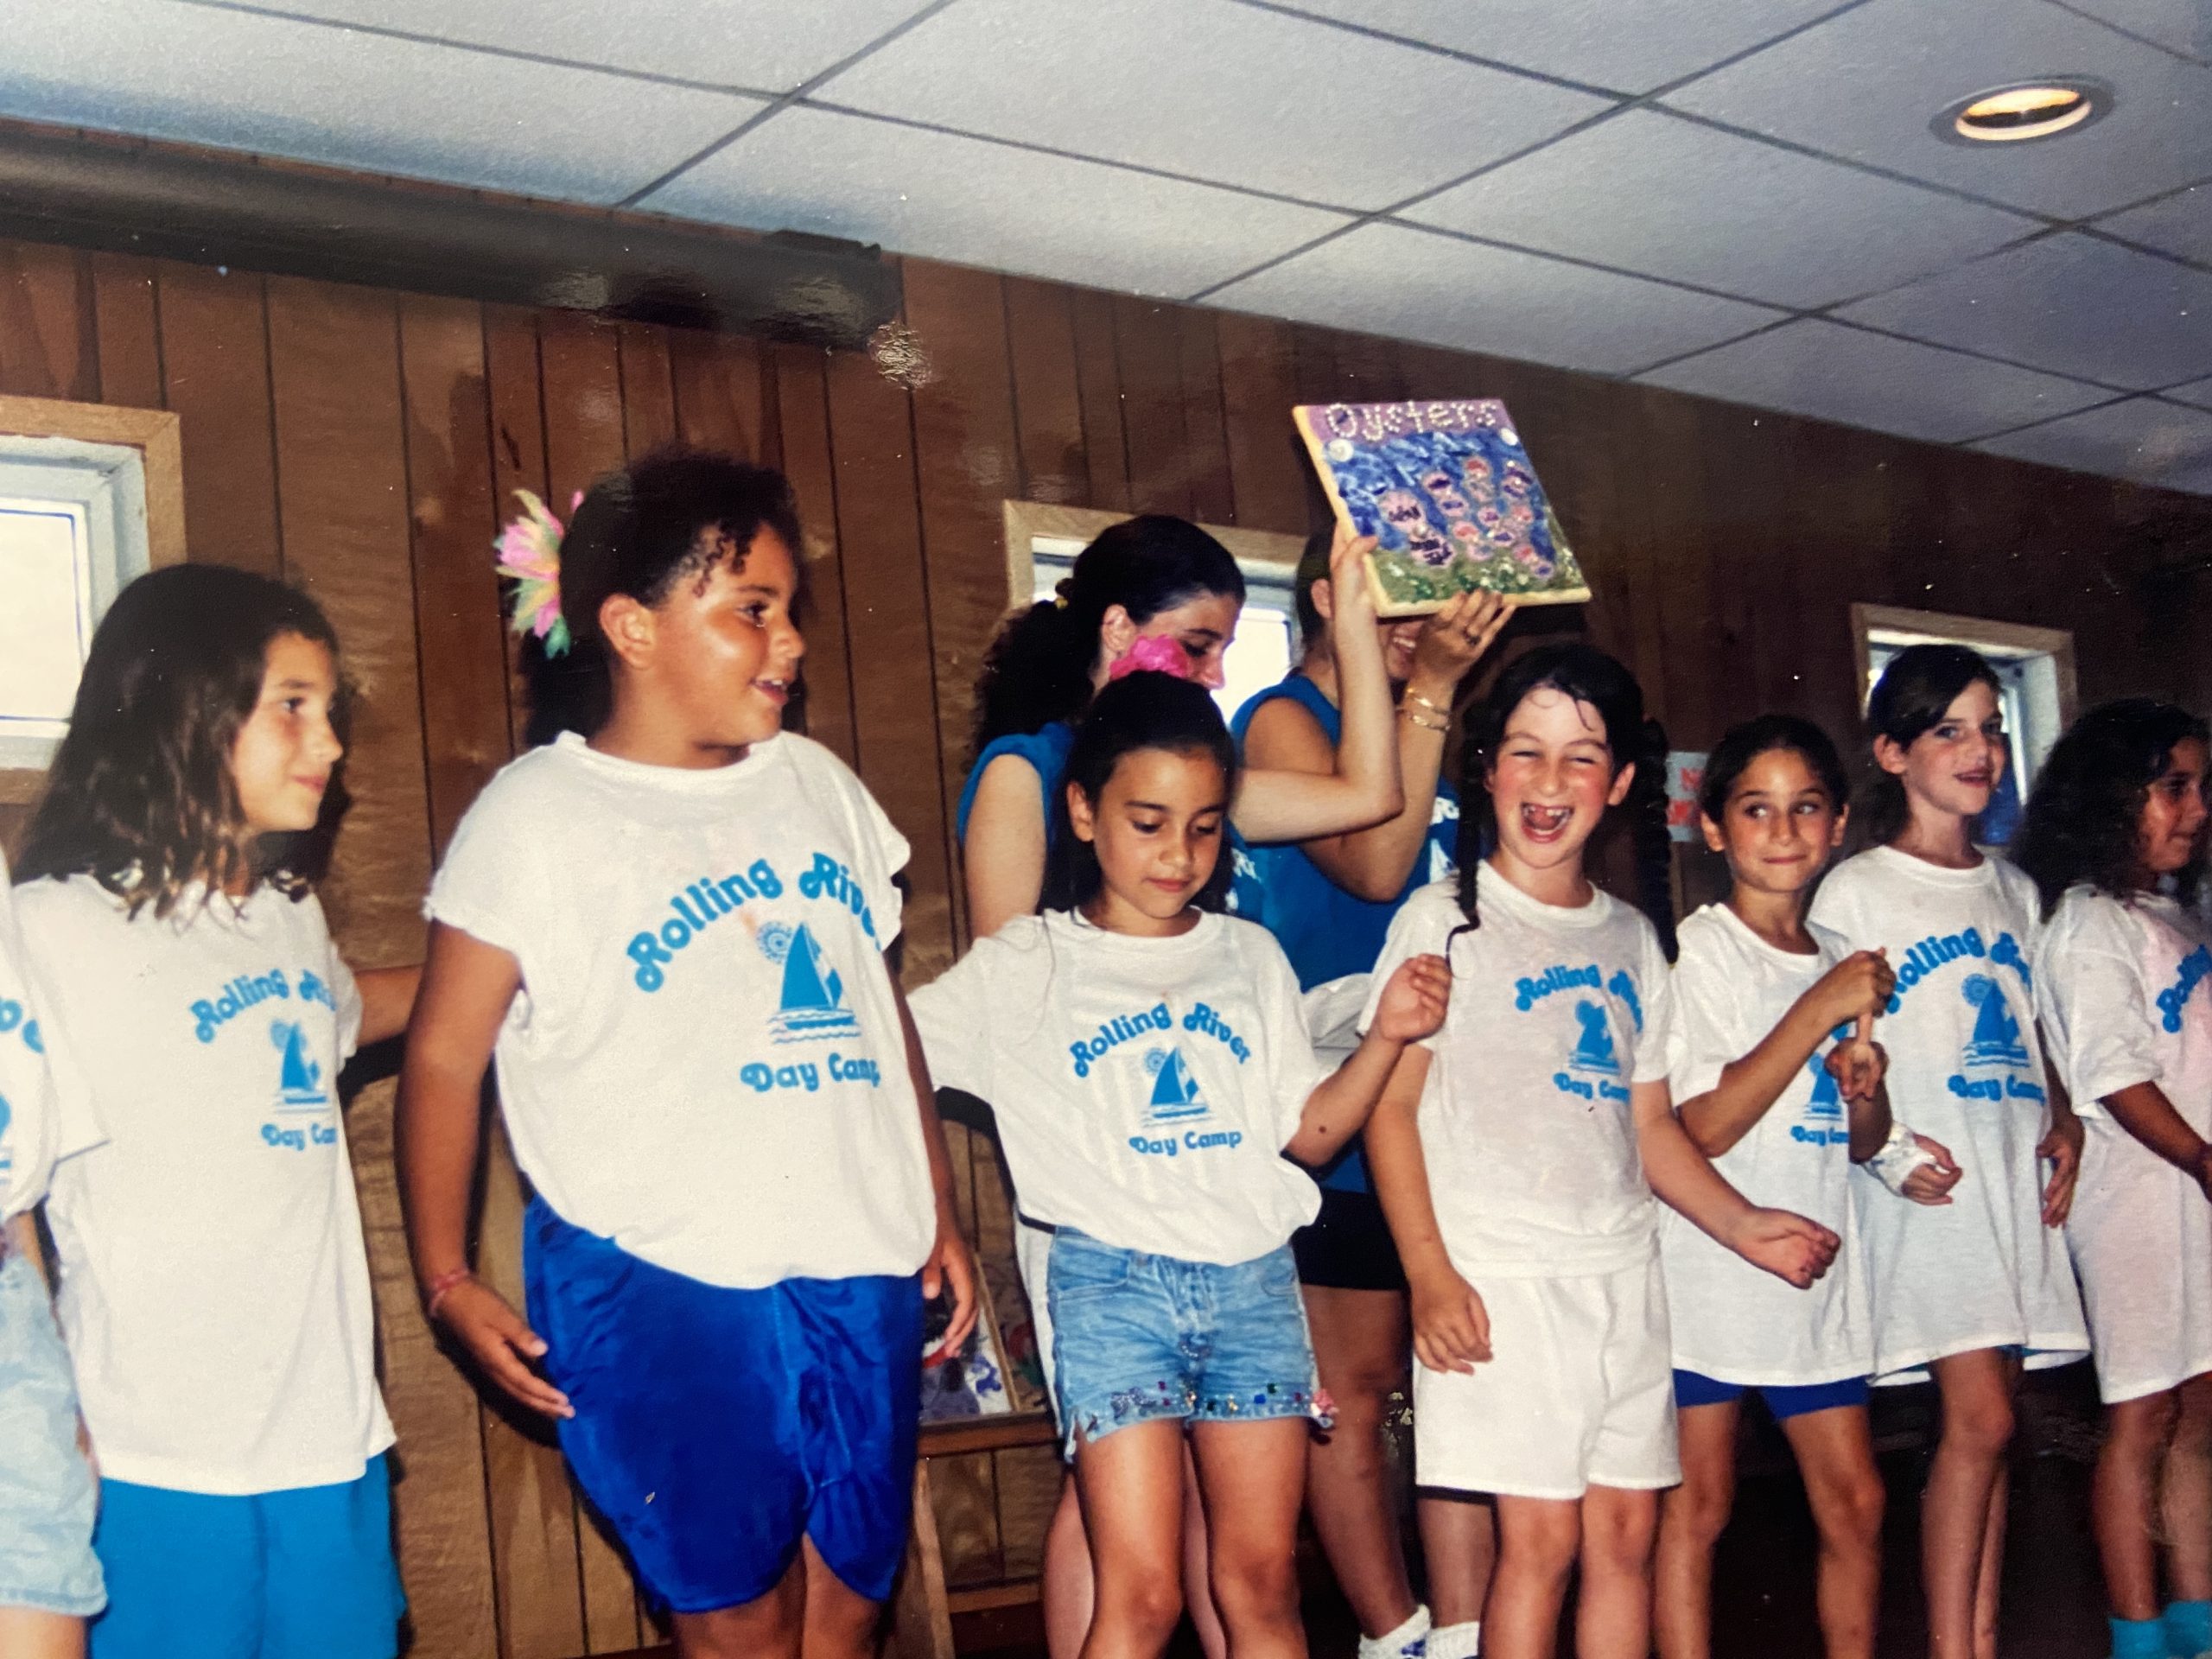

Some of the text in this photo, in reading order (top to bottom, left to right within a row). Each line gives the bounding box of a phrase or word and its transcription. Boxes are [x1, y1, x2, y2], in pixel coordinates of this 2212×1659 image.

[626, 858, 784, 993] Rolling
[1515, 964, 1601, 1011] Rolling
[189, 968, 289, 1043] Rolling
[1069, 1002, 1250, 1078] Rolling River
[740, 1062, 819, 1091] Day
[1553, 1072, 1593, 1100] Day
[1948, 1074, 2002, 1102] Day
[261, 1123, 305, 1152] Day
[1128, 1131, 1243, 1156] Day Camp
[1790, 1125, 1827, 1147] Day
